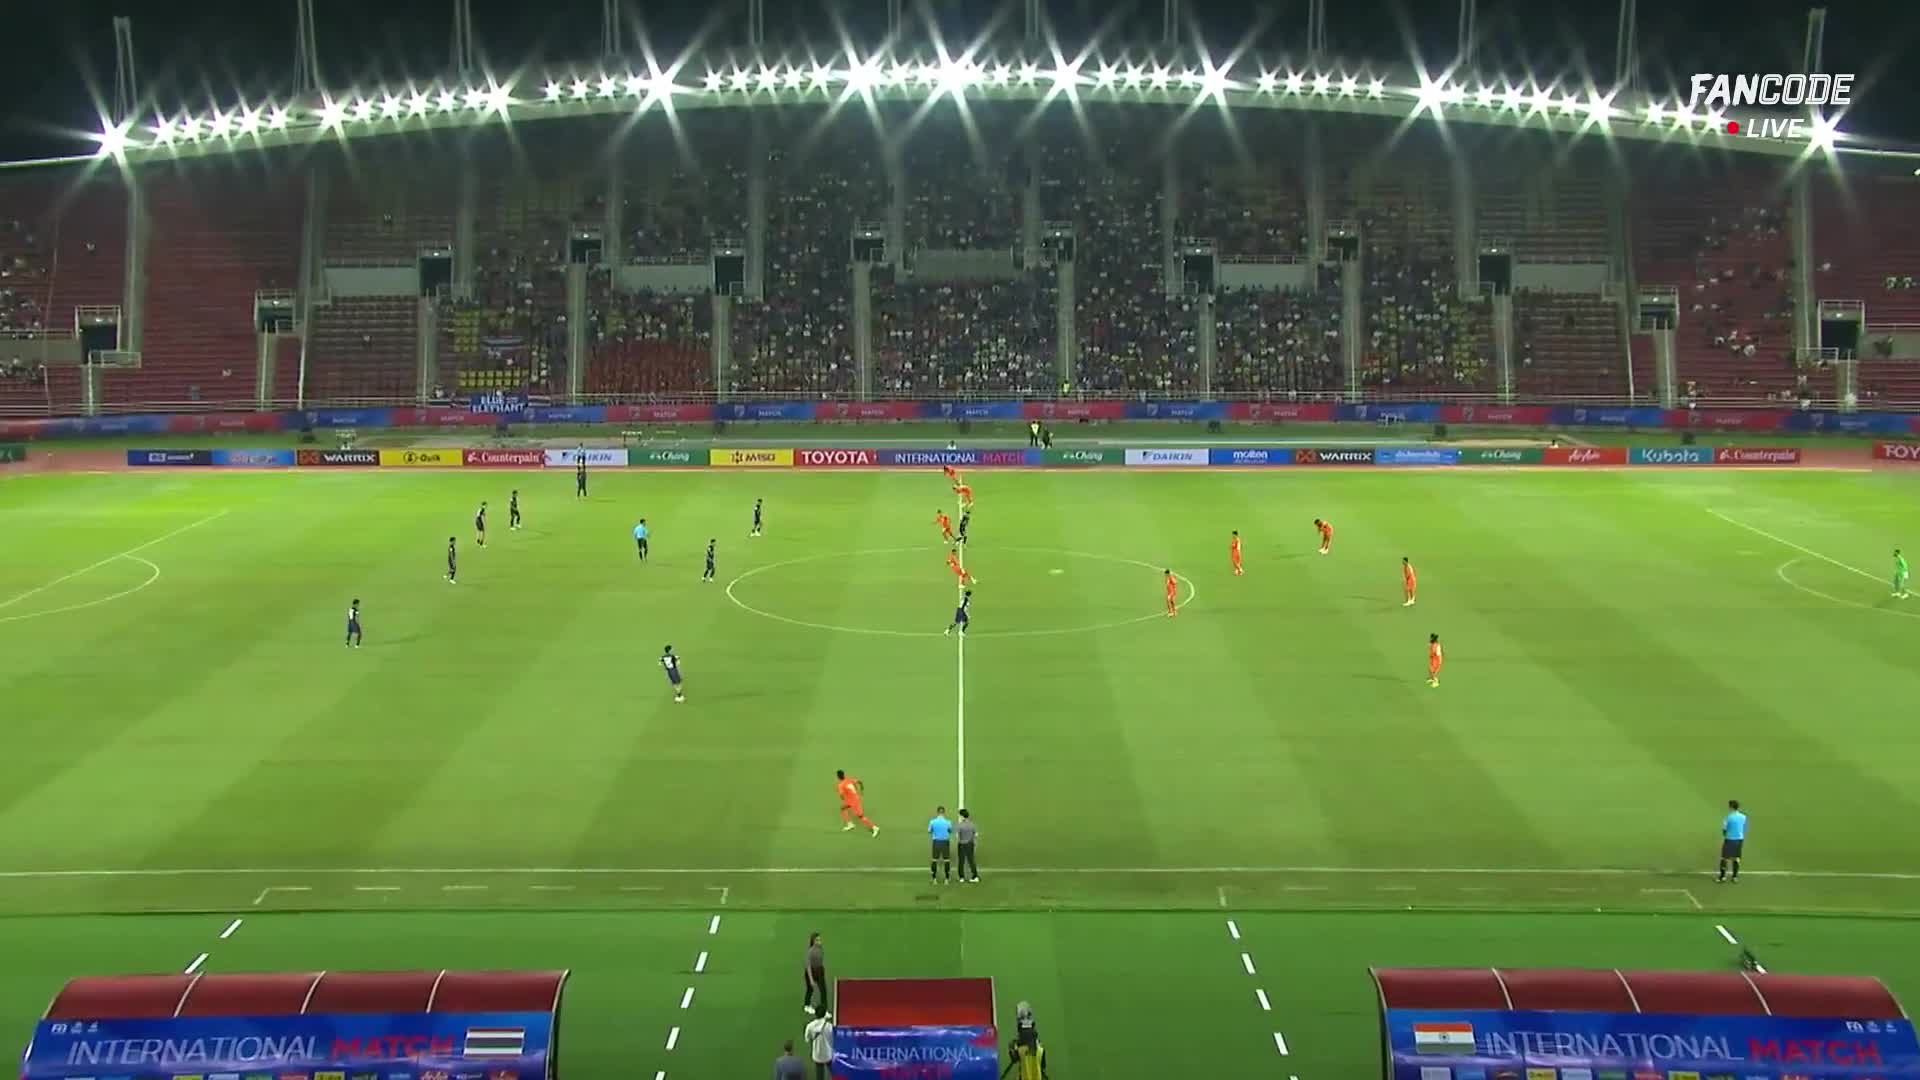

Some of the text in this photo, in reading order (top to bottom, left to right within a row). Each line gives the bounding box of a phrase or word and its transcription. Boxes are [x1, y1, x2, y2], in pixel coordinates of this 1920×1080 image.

[323, 453, 376, 462] WARRIX
[481, 451, 540, 464] Counterpain
[801, 451, 869, 464] TOYOTA
[895, 452, 1025, 463] INTERNATIONAL MATCH
[1152, 453, 1193, 461] DAIKIN
[1320, 452, 1373, 461] WARRIX
[1642, 449, 1699, 462] Kubota
[66, 1034, 457, 1066] INTERNATIONAL MATCH
[851, 1046, 975, 1061] INTERNATIONAL
[1485, 1031, 1884, 1066] INTERNATIONAL MATCH
